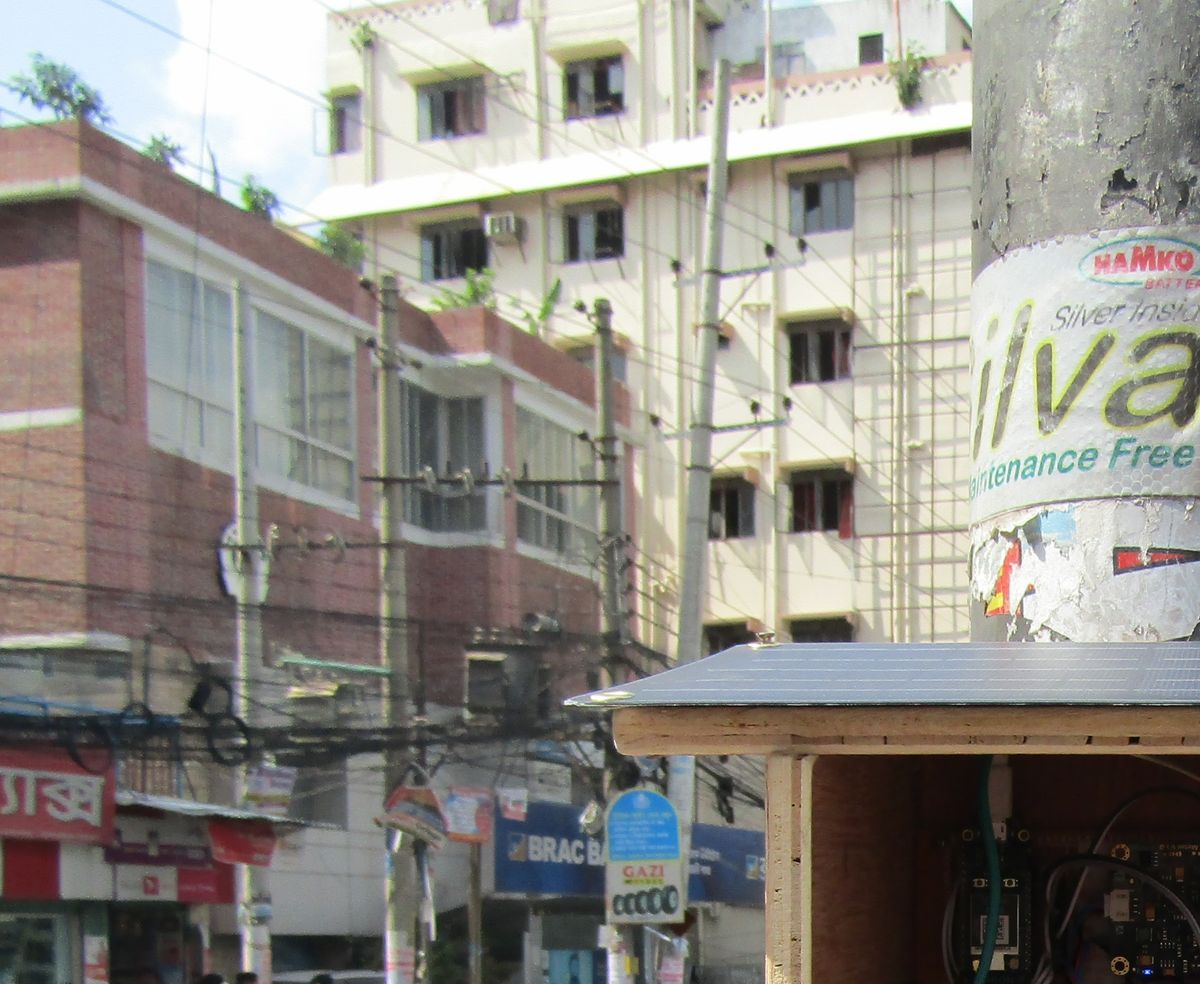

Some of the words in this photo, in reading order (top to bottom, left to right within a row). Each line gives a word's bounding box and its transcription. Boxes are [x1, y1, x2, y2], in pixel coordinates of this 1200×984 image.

[1094, 243, 1195, 275] HAMKO
[1051, 303, 1126, 331] Silver
[970, 447, 1099, 500] aintenance
[1108, 437, 1195, 469] Free
[528, 835, 584, 865] BRAC
[622, 864, 665, 878] GAZI
